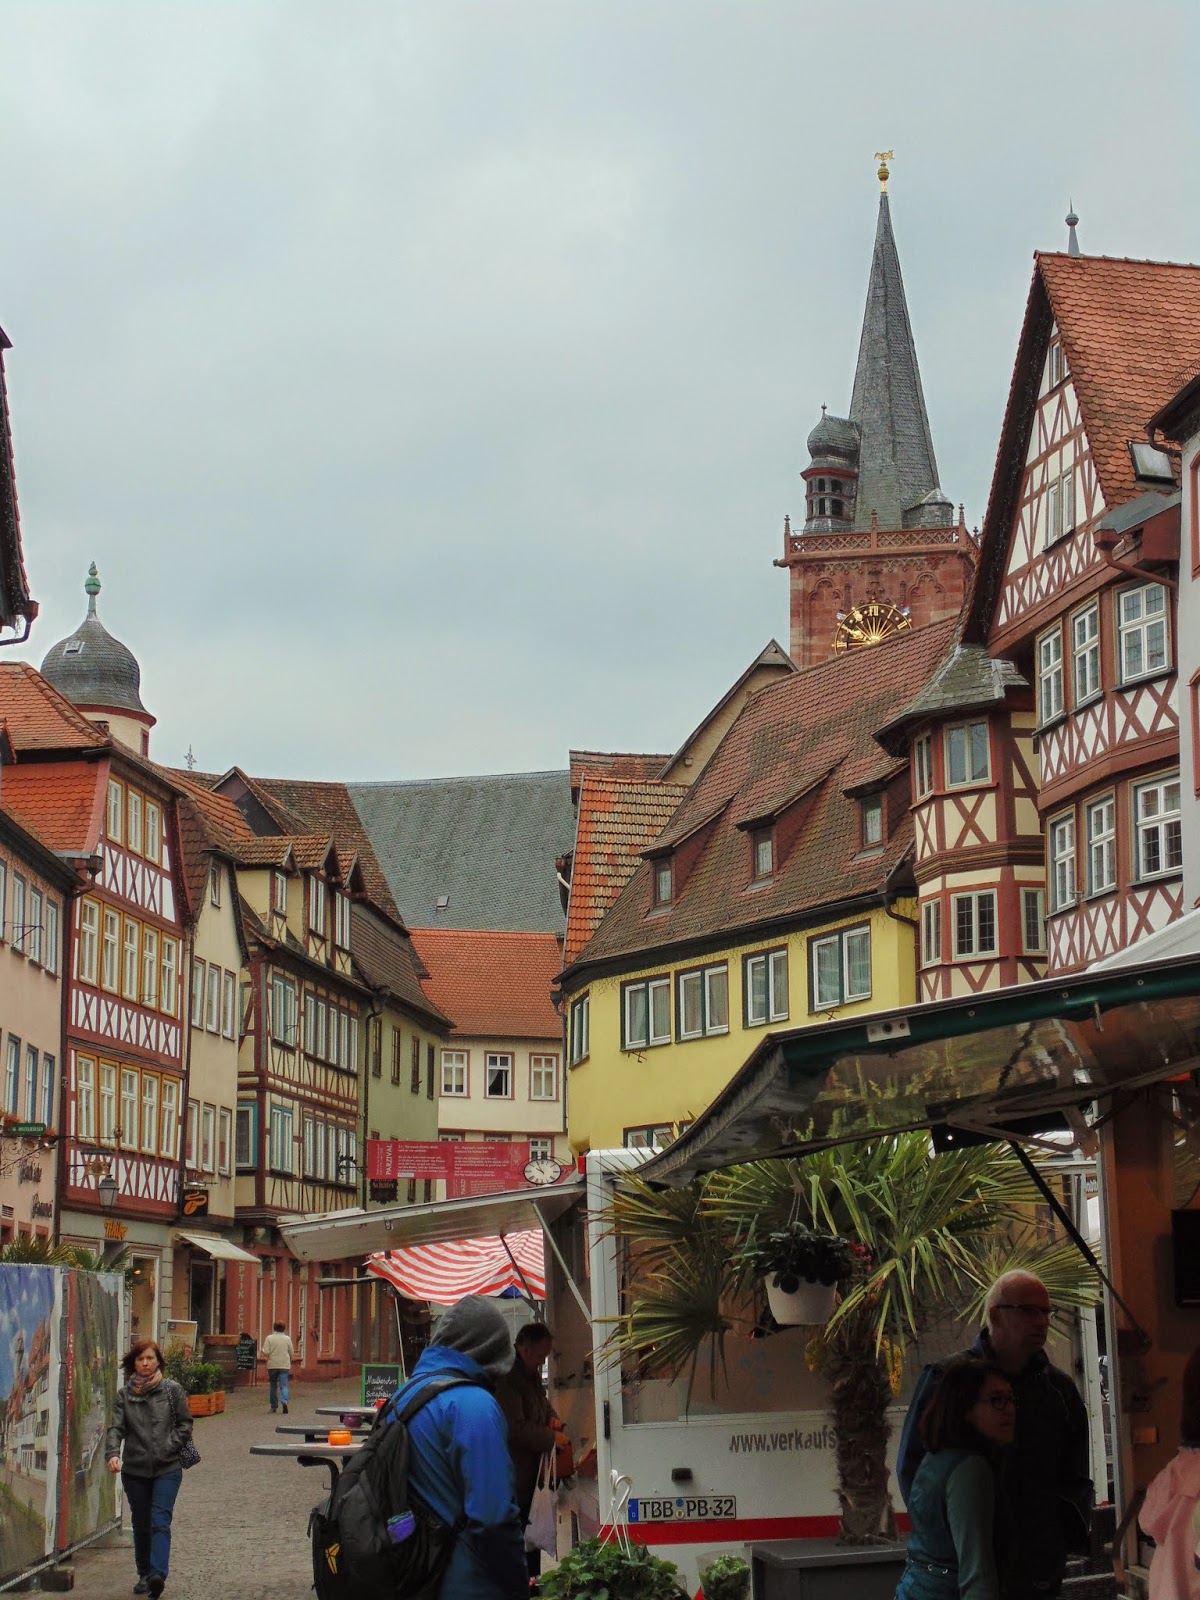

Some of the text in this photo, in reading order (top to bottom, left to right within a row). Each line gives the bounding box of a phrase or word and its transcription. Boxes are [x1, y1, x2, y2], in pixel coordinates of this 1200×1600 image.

[237, 1262, 246, 1332] PTIK SCH
[729, 1424, 838, 1453] www.verkaufs
[639, 1501, 674, 1519] TBB
